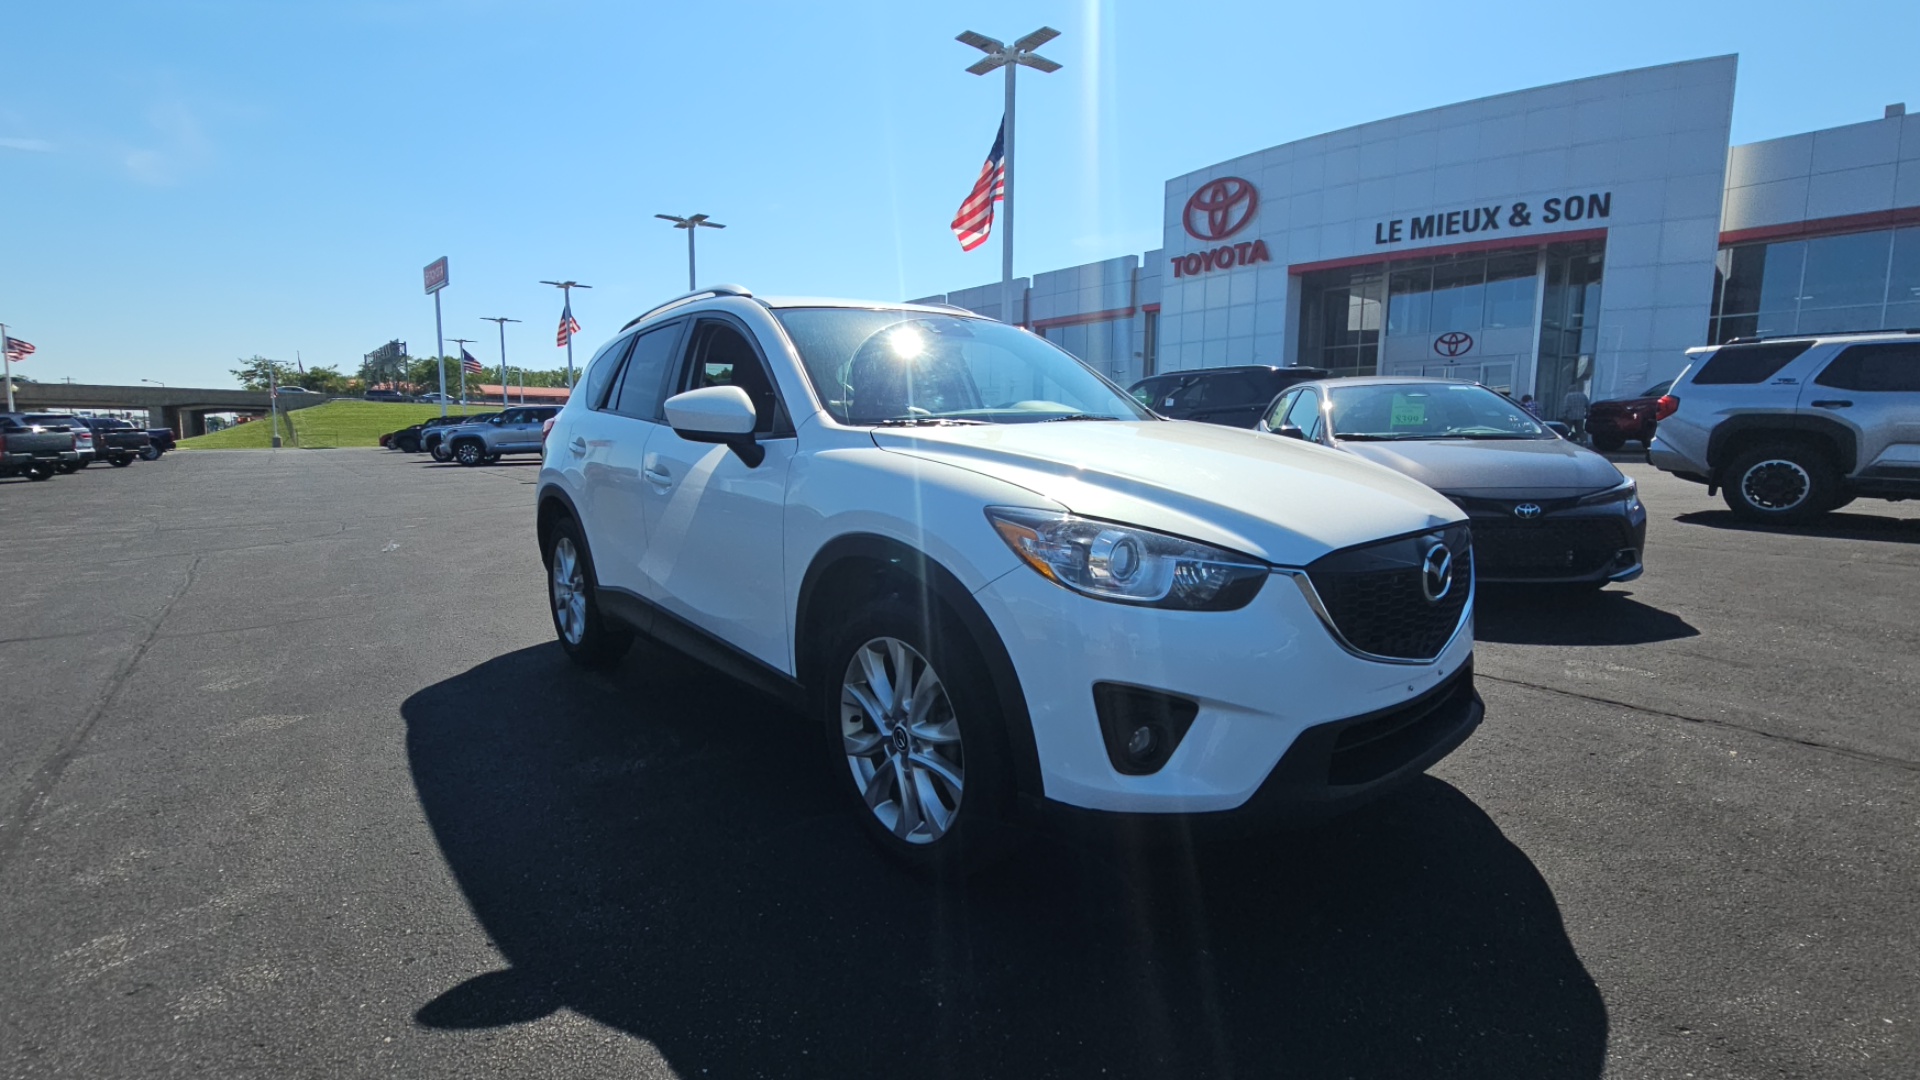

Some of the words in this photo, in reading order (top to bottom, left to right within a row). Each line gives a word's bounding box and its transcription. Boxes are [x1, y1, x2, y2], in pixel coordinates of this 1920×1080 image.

[1375, 220, 1402, 244] LE
[1410, 206, 1500, 239] MIEUX
[1508, 202, 1531, 226] &
[1542, 193, 1611, 223] SON
[1171, 240, 1269, 277] TOYOTA
